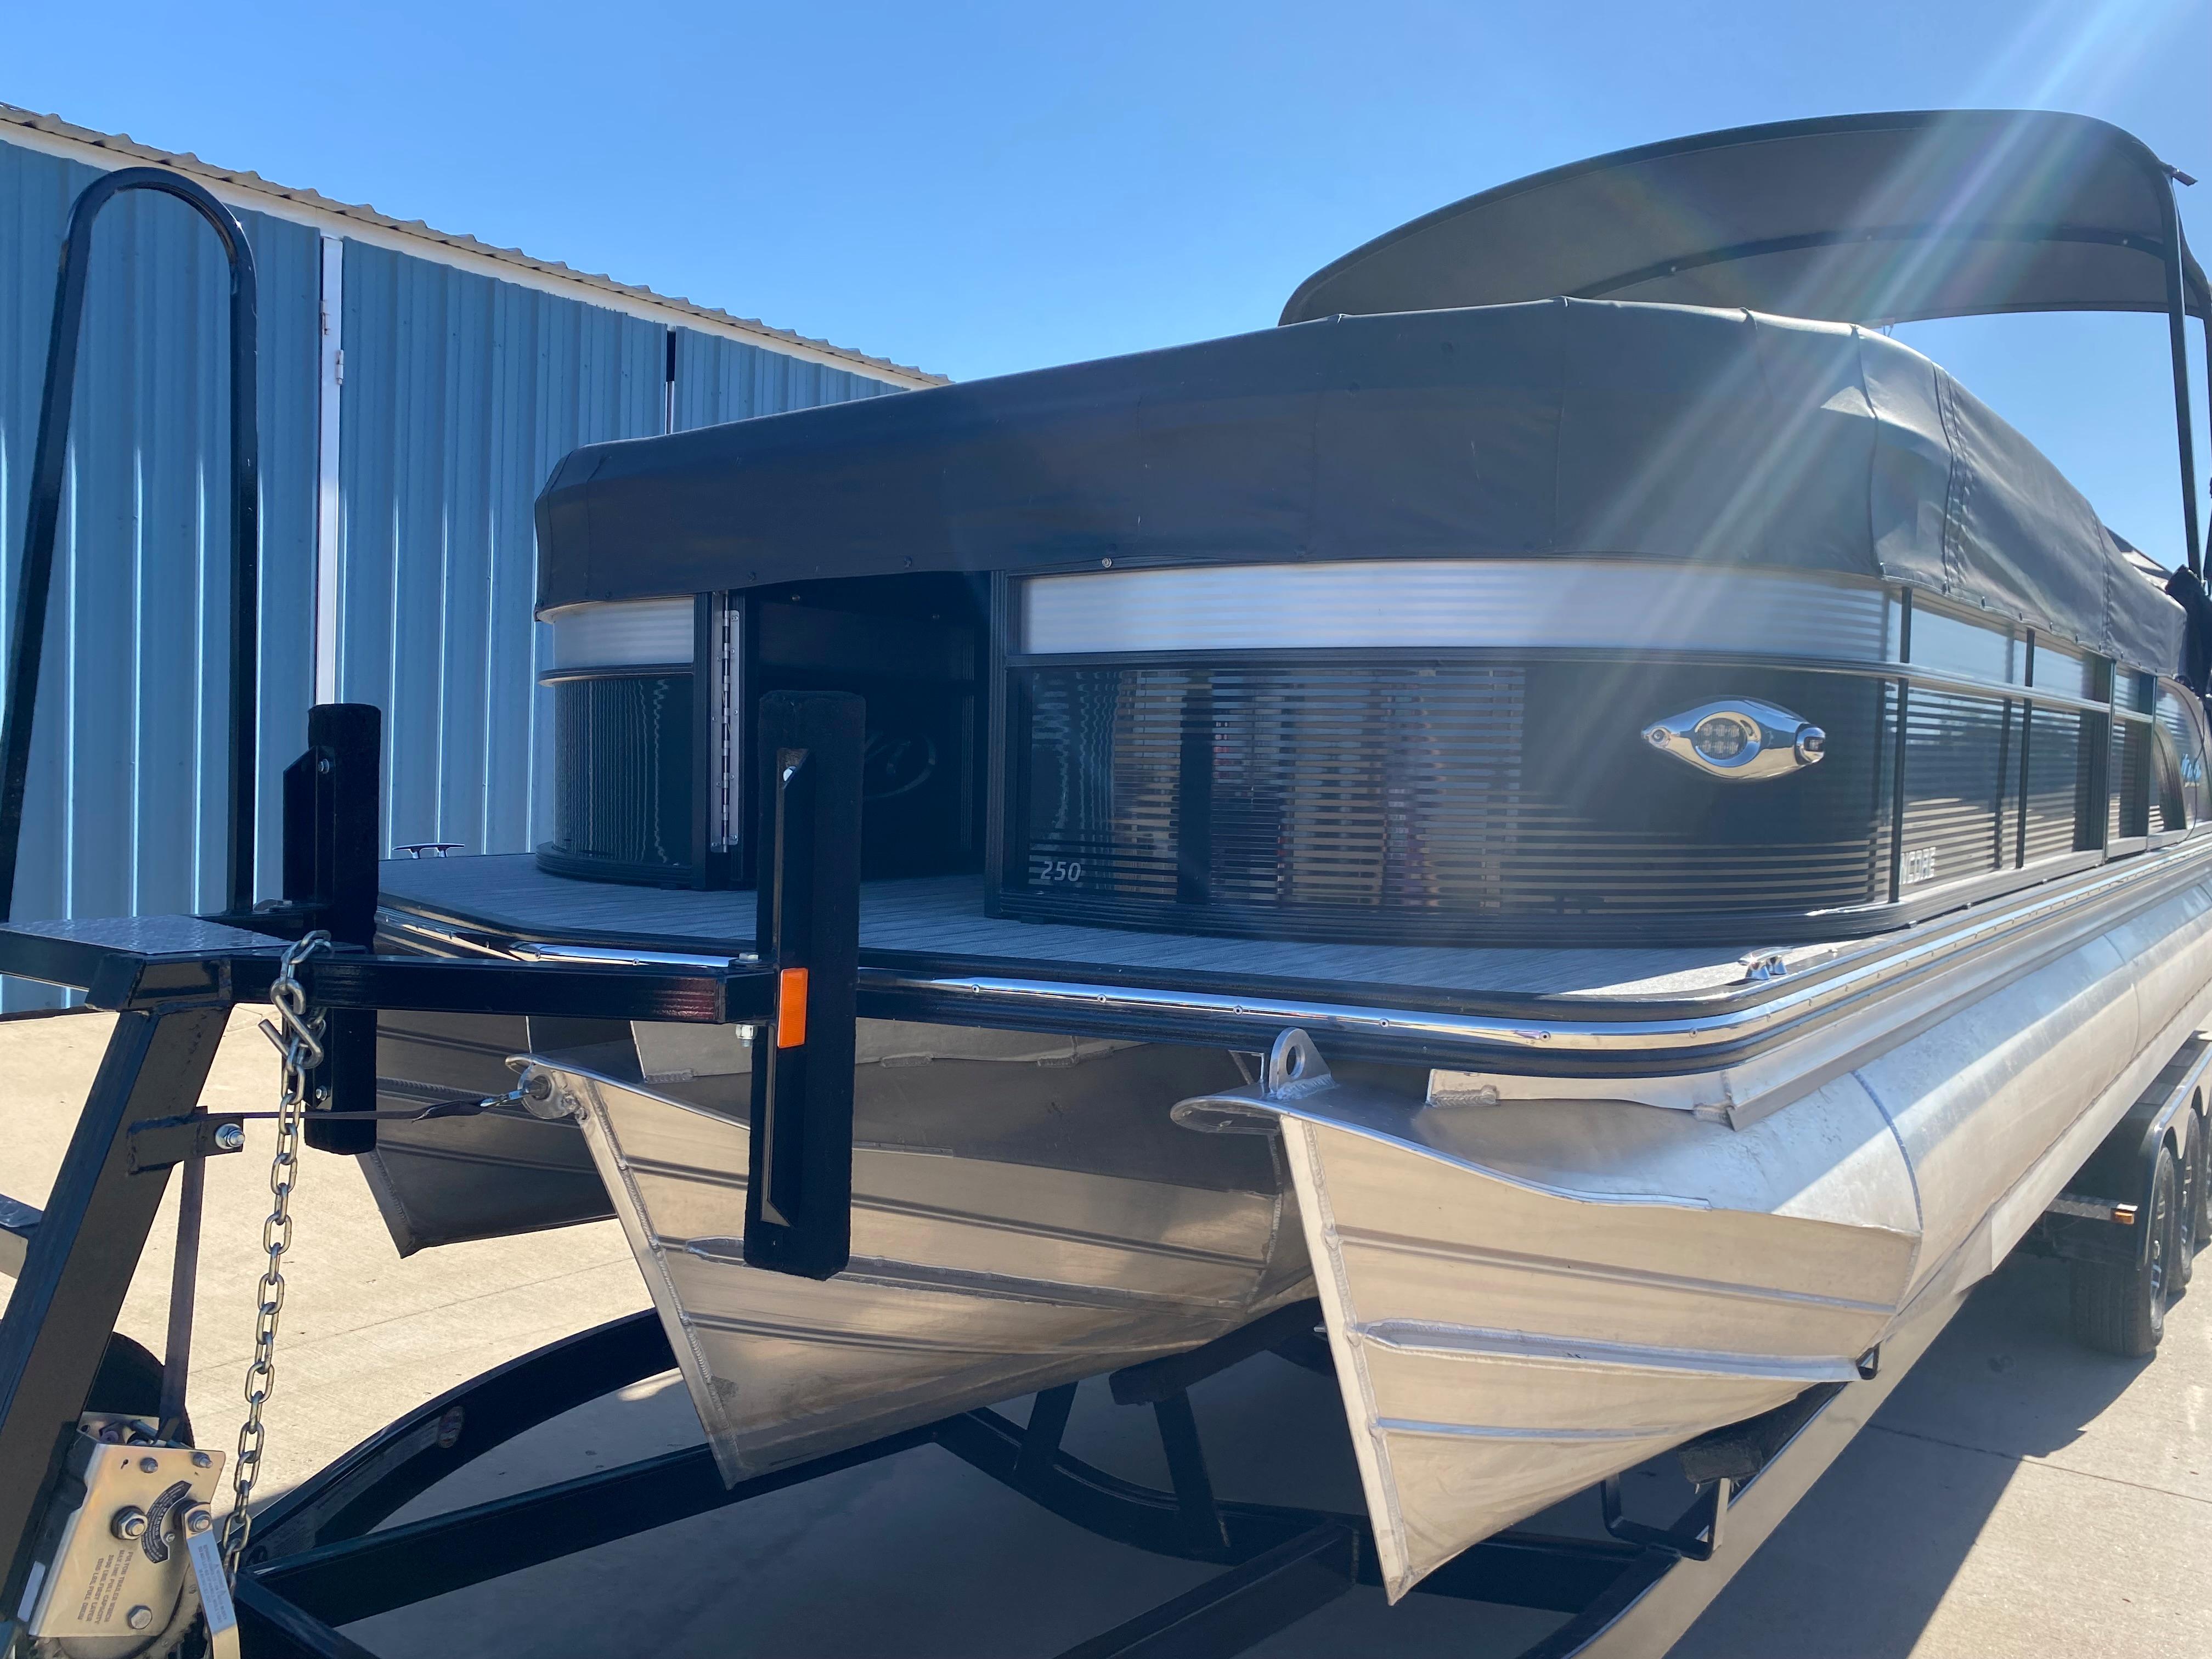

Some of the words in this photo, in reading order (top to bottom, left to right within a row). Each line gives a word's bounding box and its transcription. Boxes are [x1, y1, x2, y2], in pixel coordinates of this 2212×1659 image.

[1041, 861, 1081, 882] 250
[1899, 847, 1937, 885] NCORE
[105, 1579, 114, 1593] PULL
